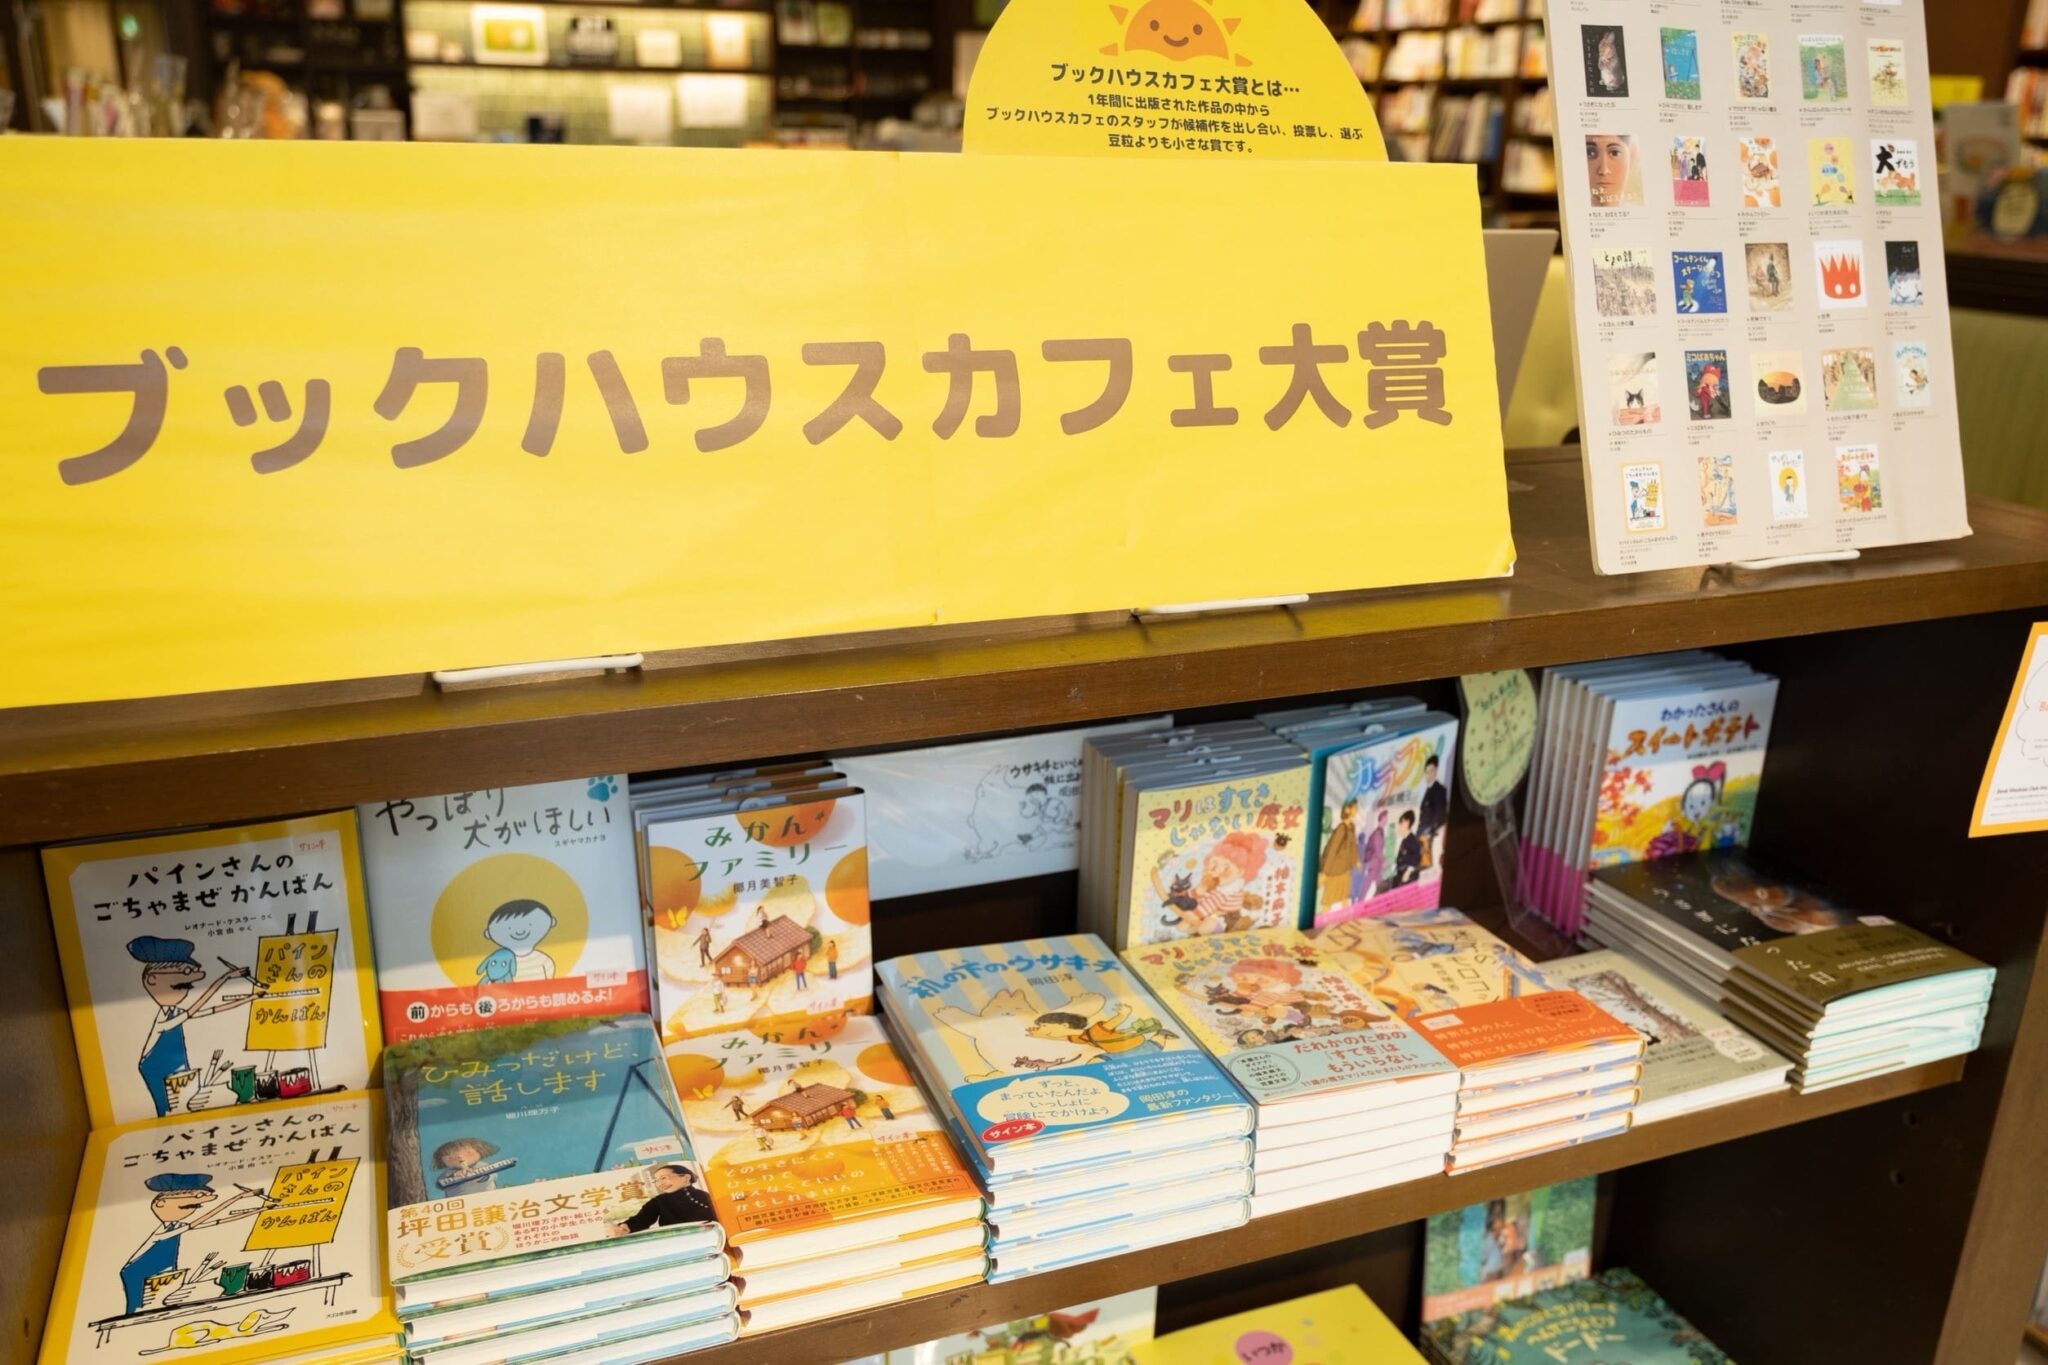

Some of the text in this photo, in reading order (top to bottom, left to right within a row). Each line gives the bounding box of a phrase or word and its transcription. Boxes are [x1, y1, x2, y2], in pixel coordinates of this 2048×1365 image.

[1051, 63, 1299, 96] ブックハウスカフェ大賞とは…
[1088, 93, 1270, 116] 1年間に出版された作品の中から
[987, 107, 1363, 140] ブックハウスカフェのスタッフが候補作を出し合い、投票し、選ぶ
[1108, 134, 1254, 154] 豆粒よりも小さな賞です。
[37, 319, 1453, 487] ブックハウスカフェ大賞
[1661, 700, 1739, 721] わかったさんの
[1620, 713, 1760, 759] スイートポテト
[463, 806, 611, 850] 犬がほしい
[705, 815, 806, 847] みかん
[554, 833, 607, 848] スギヤマカナヨ
[128, 854, 294, 888] パインさんの
[684, 843, 848, 881] ファミリー
[264, 943, 328, 963] パイン
[266, 963, 328, 983] さんの
[256, 1003, 326, 1024] かんばん
[721, 1027, 822, 1049] みかん
[1294, 1031, 1407, 1054] だれかのための
[423, 1042, 638, 1084] ひみつだけど、
[705, 1041, 870, 1070] ファミリー
[1328, 1053, 1419, 1074] もういらない
[459, 1070, 606, 1105] 話します
[1000, 1088, 1101, 1101] まっていたんだよ
[1004, 1106, 1109, 1121] 冒険にでかけよう
[1030, 1098, 1091, 1108] いっしょに
[162, 1113, 325, 1145] パインさんの
[989, 1122, 1037, 1139] サイン本
[281, 1166, 349, 1183] パイン
[279, 1180, 345, 1198] さんの
[261, 1209, 338, 1229] かんばん
[400, 1198, 465, 1219] 第40回
[414, 1230, 493, 1261] 受賞
